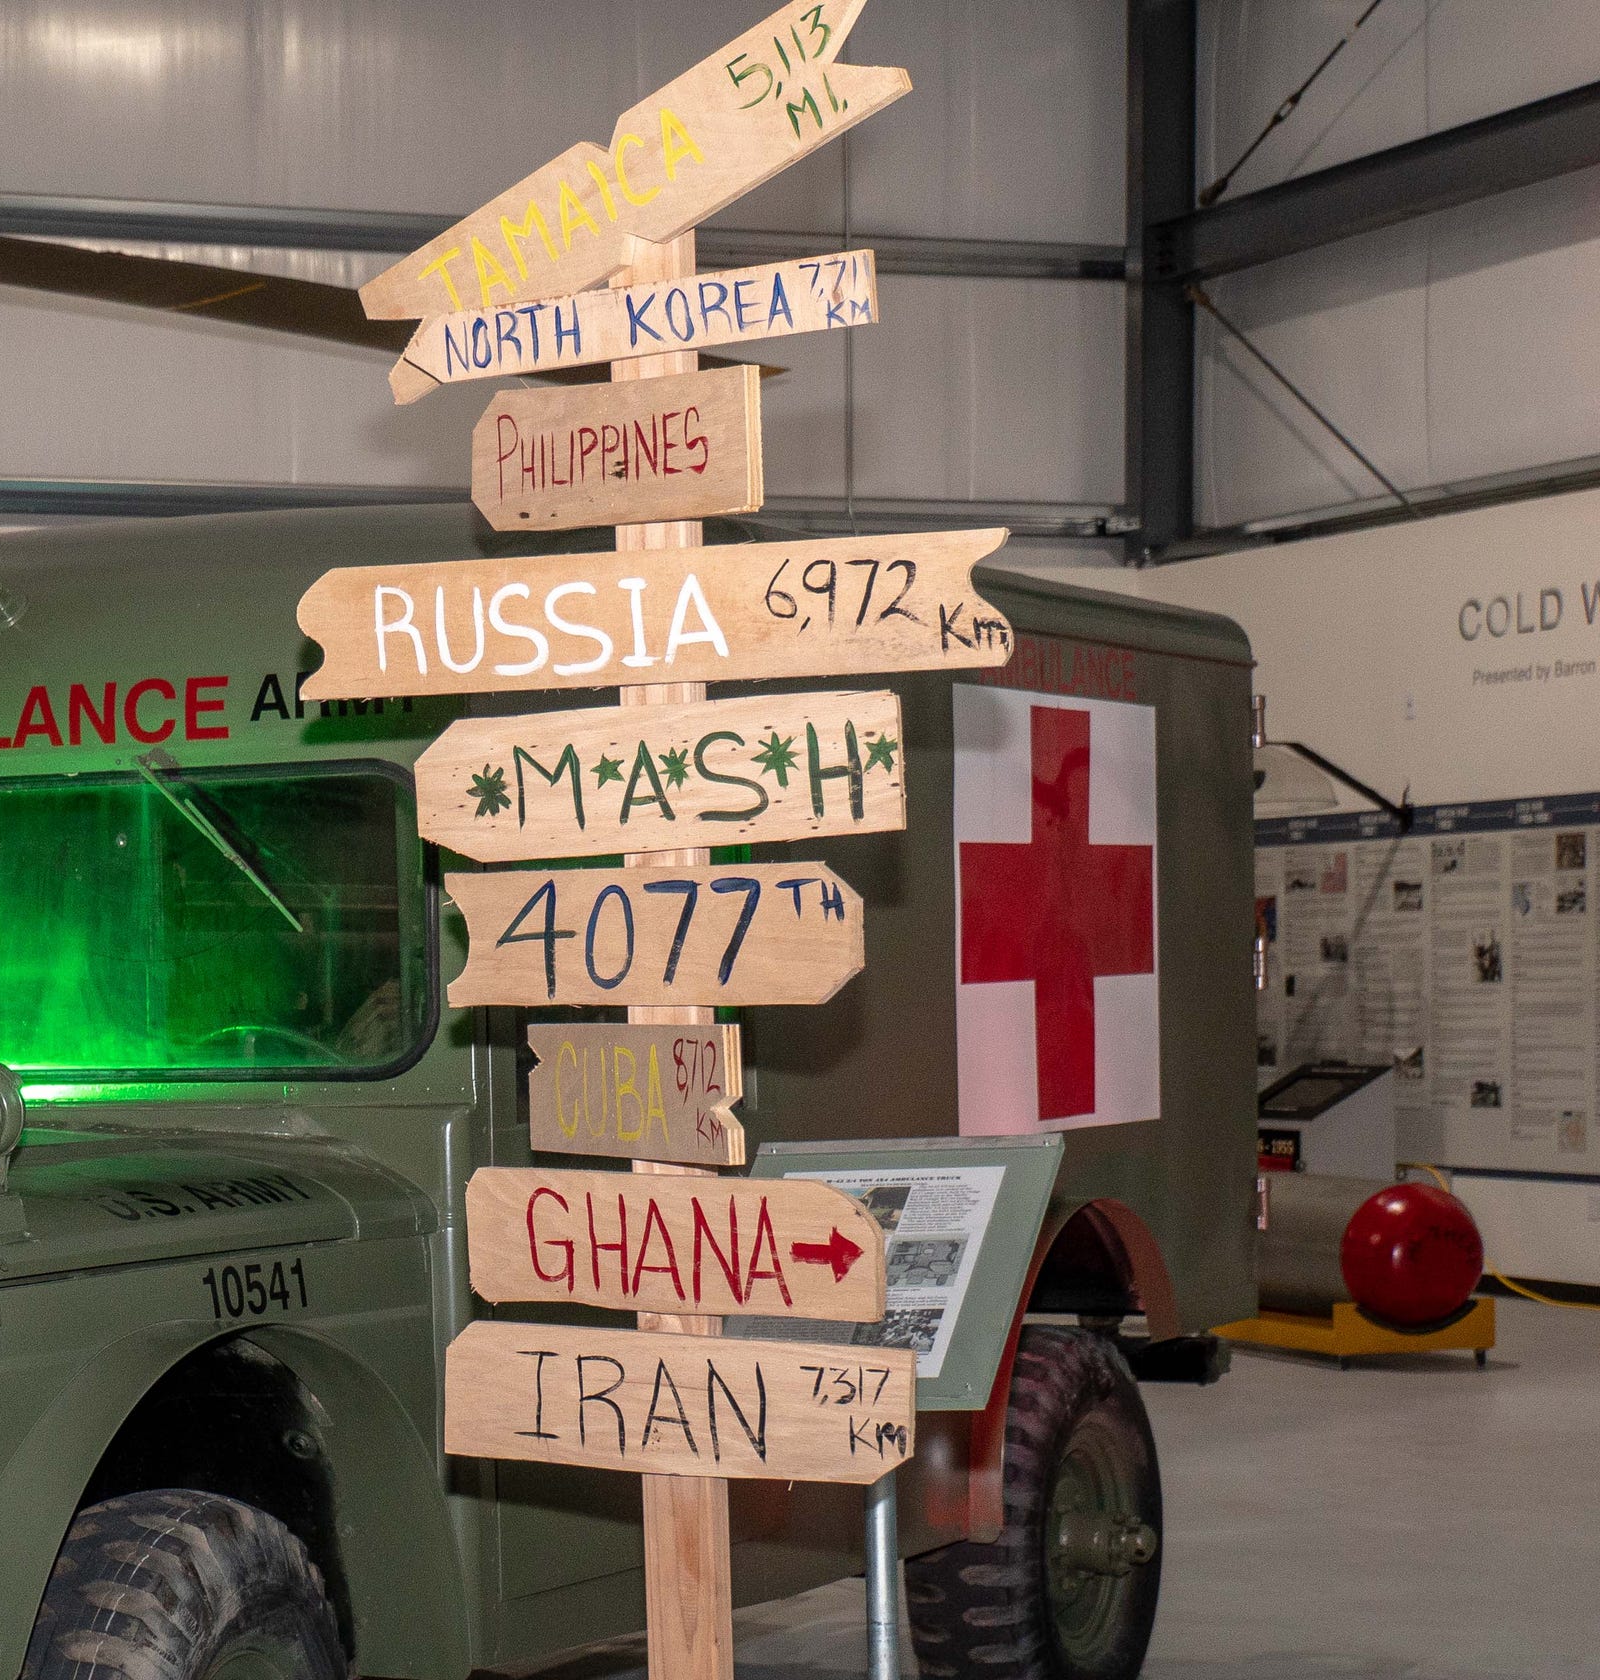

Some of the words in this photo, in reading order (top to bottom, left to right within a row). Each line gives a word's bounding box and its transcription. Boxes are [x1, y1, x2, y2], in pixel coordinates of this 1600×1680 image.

[723, 4, 831, 110] 5,113
[444, 299, 582, 378] NORTH
[625, 272, 793, 349] KOREA
[826, 297, 872, 329] KM
[496, 406, 709, 504] PHILIPPINES
[374, 572, 730, 677] RUSSIA
[764, 559, 924, 636] 6,972
[1459, 587, 1563, 641] COLD
[1473, 664, 1532, 685] Presented
[1536, 664, 1552, 682] by
[1554, 660, 1597, 678] Barron
[555, 1042, 671, 1145] CUBA
[672, 1038, 721, 1109] 8,712
[696, 1107, 725, 1154] KM
[99, 1189, 195, 1221] U.S.
[180, 1174, 311, 1210] ARMY
[203, 1257, 308, 1319] 10541
[526, 1187, 794, 1308] GHANA
[514, 1350, 767, 1464] IRAN
[799, 1365, 891, 1406] 7,317
